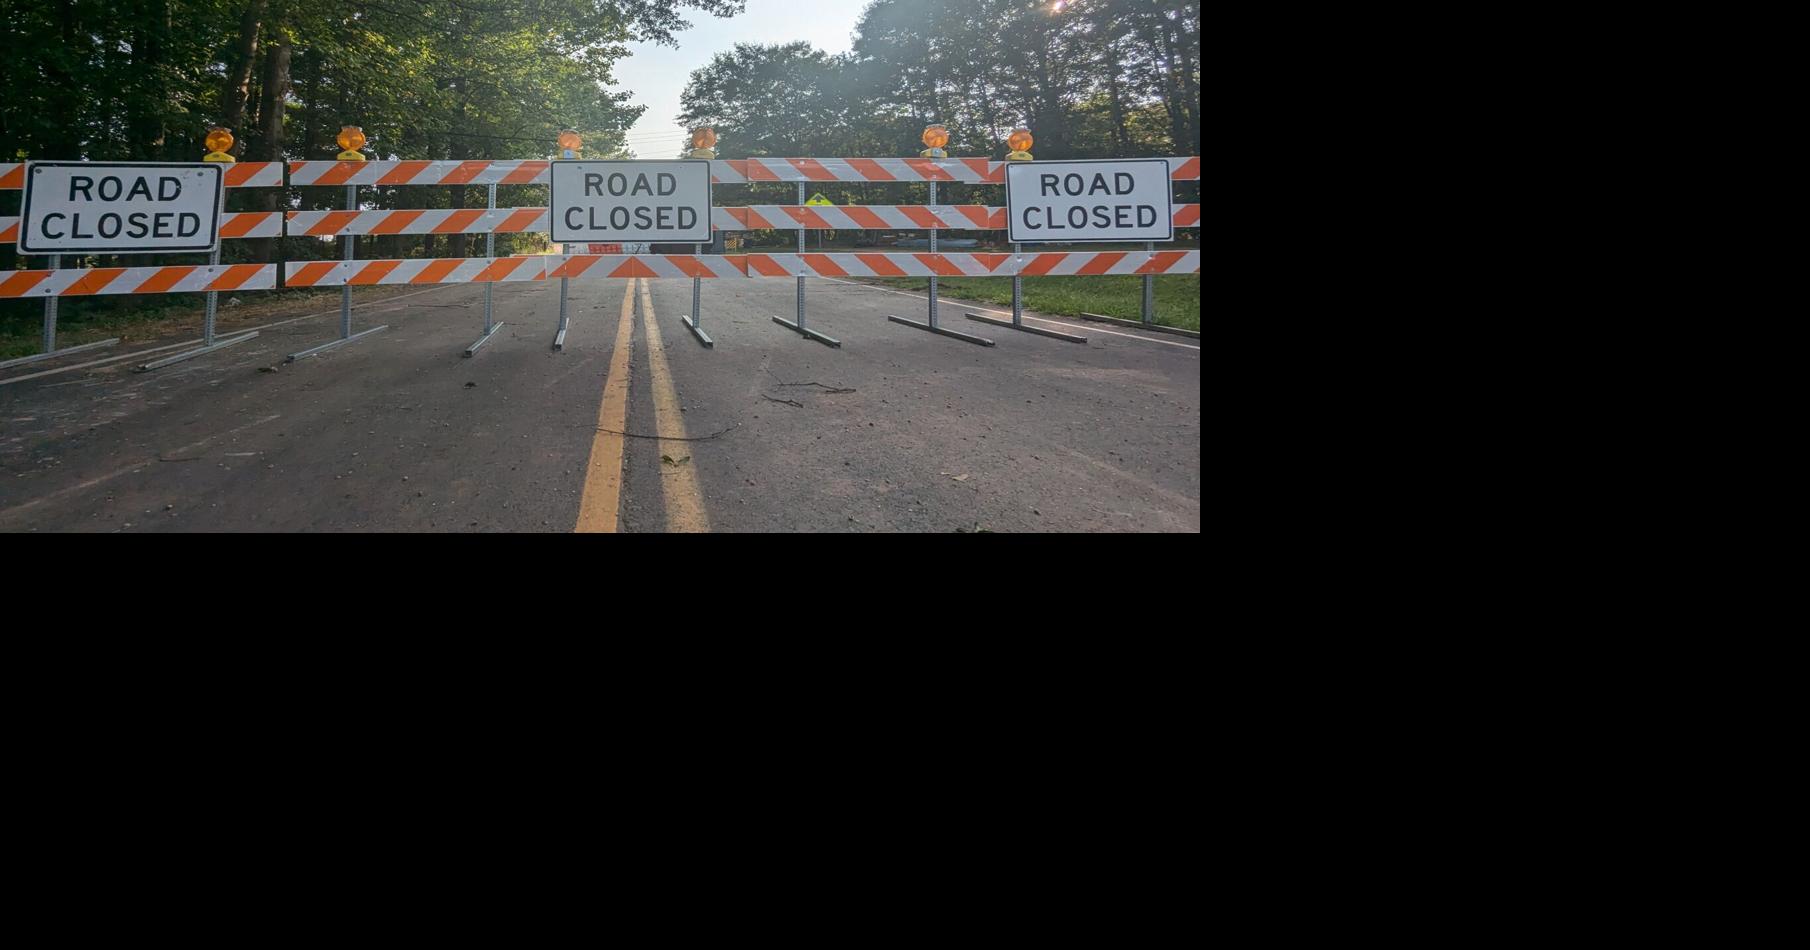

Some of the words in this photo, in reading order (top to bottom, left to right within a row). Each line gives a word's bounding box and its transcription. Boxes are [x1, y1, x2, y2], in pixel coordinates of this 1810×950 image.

[69, 176, 182, 202] ROAD
[584, 172, 677, 197] ROAD
[1040, 172, 1135, 197] ROAD
[41, 212, 201, 239] CLOSED
[564, 206, 697, 230] CLOSED
[1022, 204, 1157, 230] CLOSED
